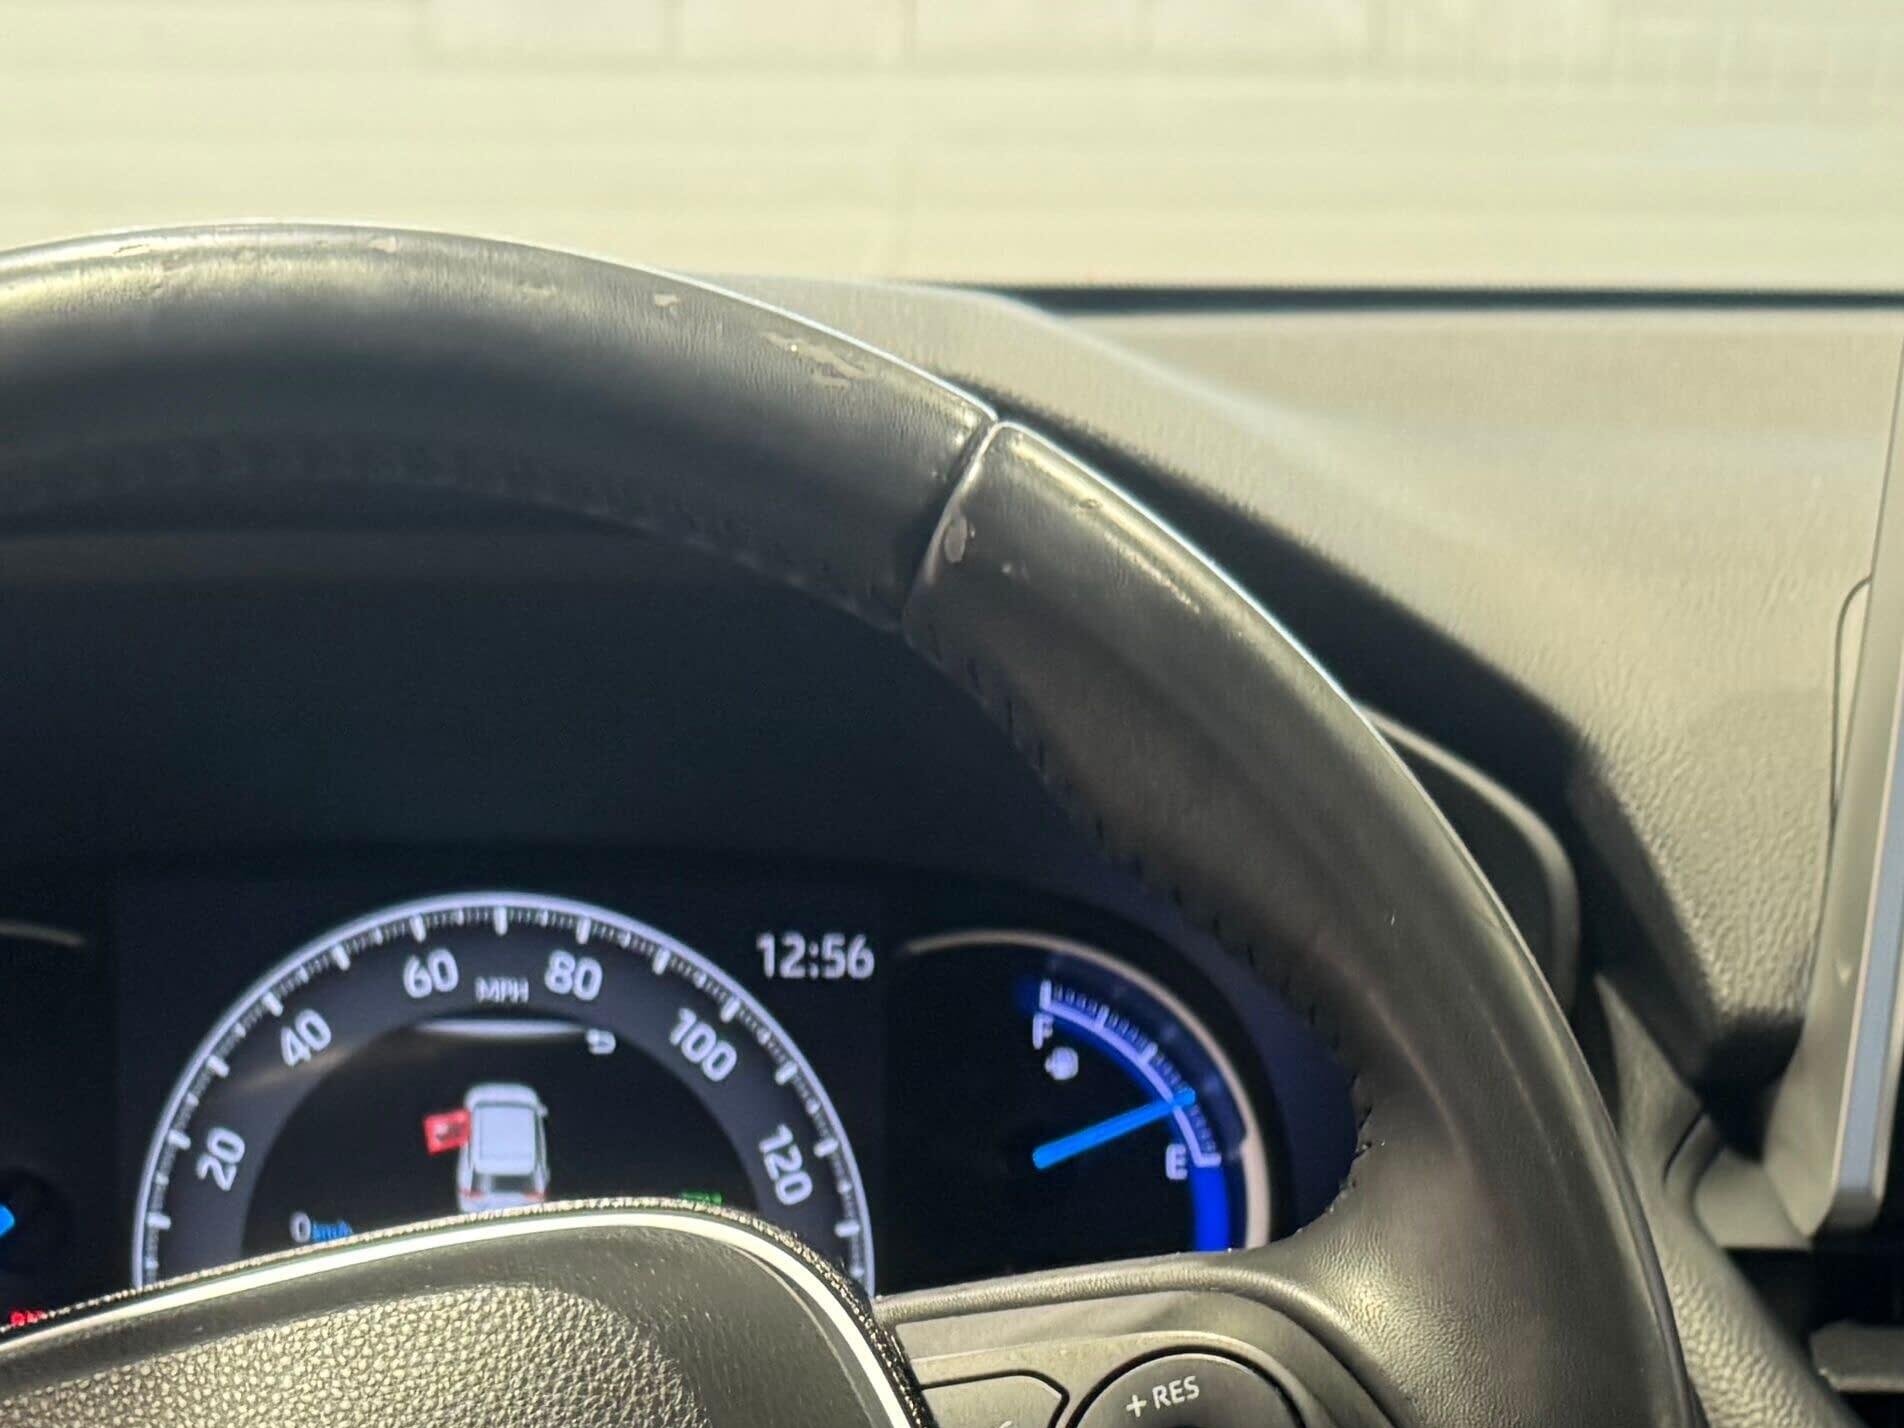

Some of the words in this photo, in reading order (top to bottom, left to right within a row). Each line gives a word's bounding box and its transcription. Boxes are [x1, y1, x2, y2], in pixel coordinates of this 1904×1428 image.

[402, 948, 460, 999] 60
[544, 950, 604, 1001] 80
[757, 933, 875, 980] 12:56
[475, 977, 530, 1004] MPH
[279, 1008, 333, 1067] 40
[667, 1009, 738, 1082] 100
[1032, 1016, 1054, 1050] F
[196, 1126, 247, 1191] 20
[757, 1125, 815, 1207] 120
[1165, 1144, 1189, 1180] E
[1152, 1376, 1200, 1411] RES
